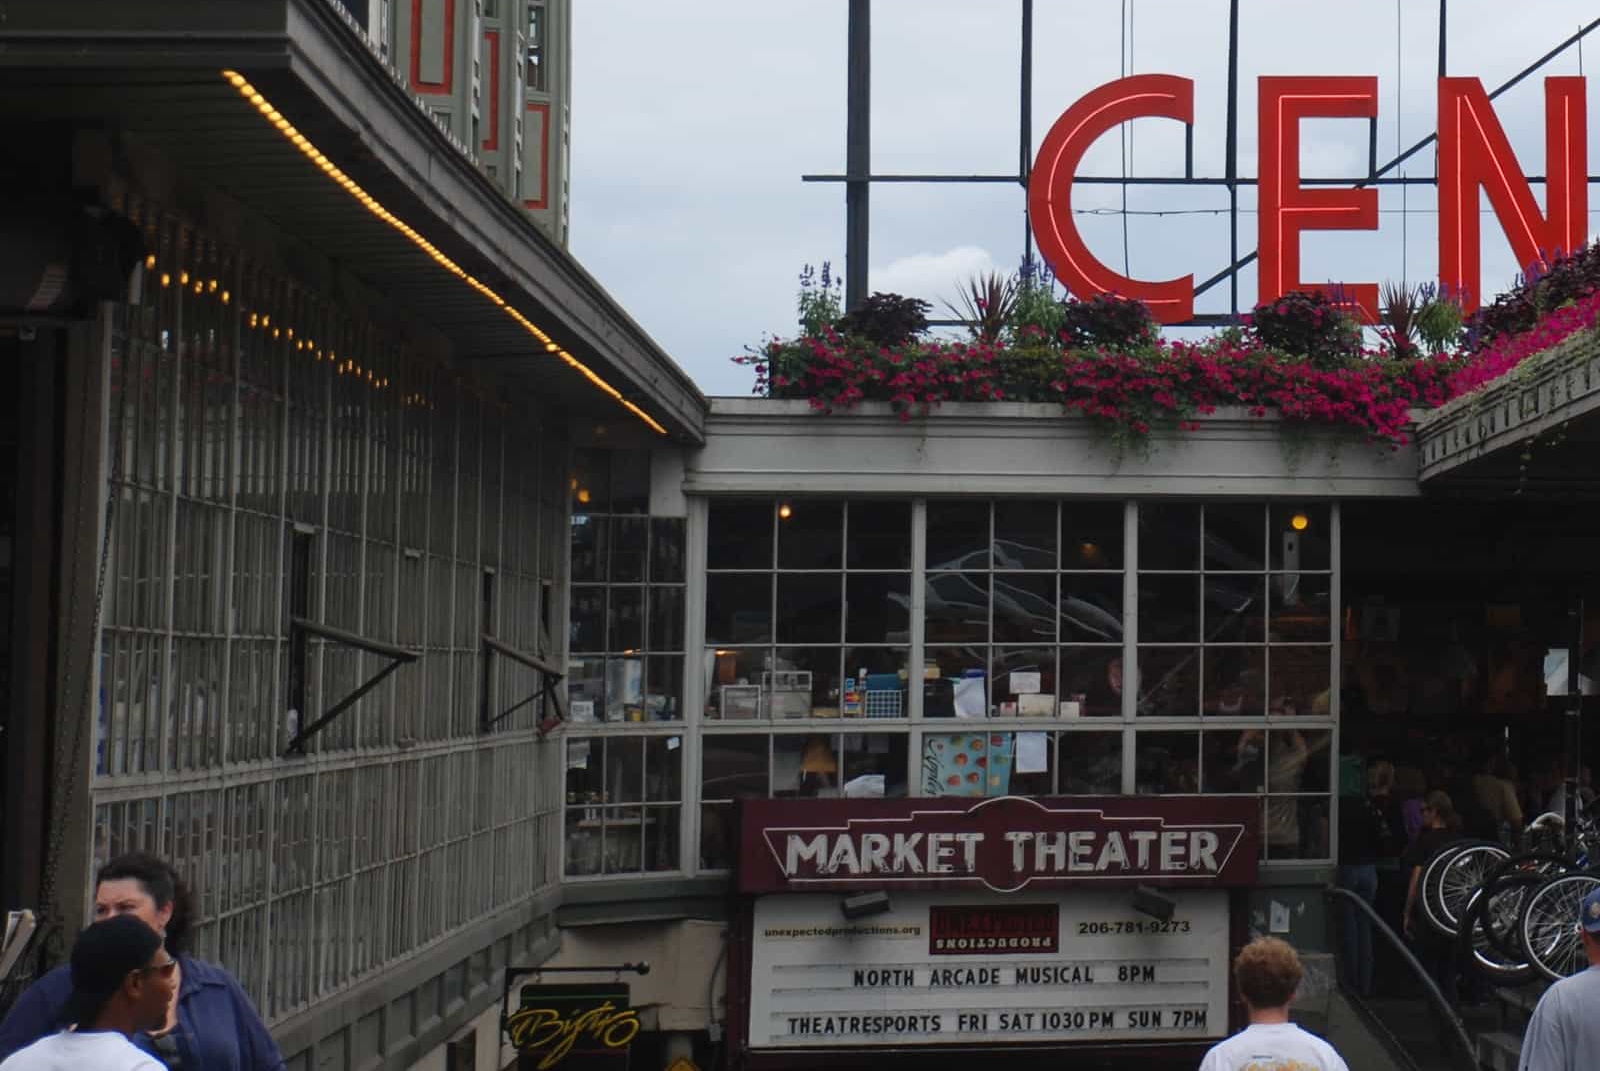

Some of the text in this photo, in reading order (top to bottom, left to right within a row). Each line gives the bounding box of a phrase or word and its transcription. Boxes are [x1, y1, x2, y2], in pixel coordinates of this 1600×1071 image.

[785, 831, 1219, 875] MARKET THEATER
[1078, 920, 1191, 935] 206-781-9273
[853, 965, 1156, 987] NORTH ARCADE MUSICAL 8PM
[787, 1015, 941, 1034] THEATRESPORTS
[958, 1014, 988, 1031] FRI
[999, 1013, 1034, 1030] SAT
[1127, 1010, 1162, 1029] SUN
[1172, 1009, 1207, 1029] 7PM
